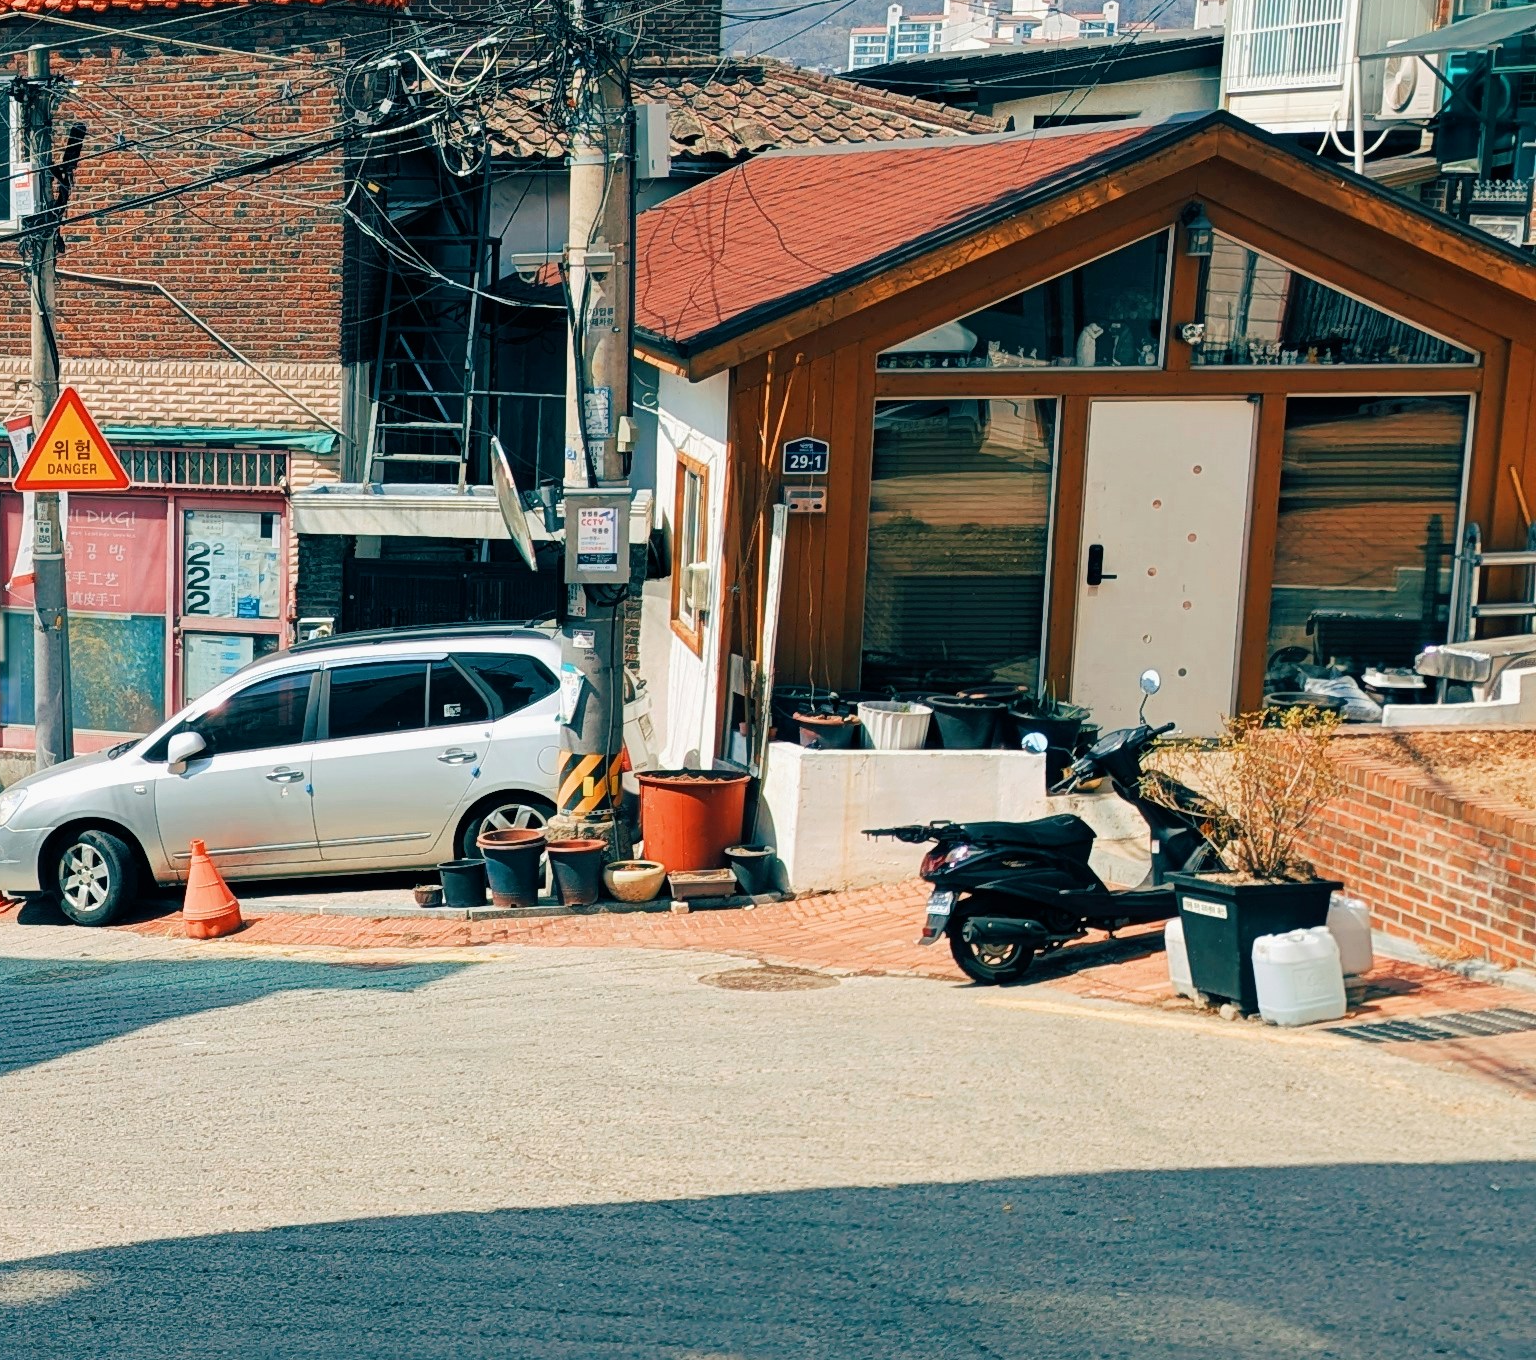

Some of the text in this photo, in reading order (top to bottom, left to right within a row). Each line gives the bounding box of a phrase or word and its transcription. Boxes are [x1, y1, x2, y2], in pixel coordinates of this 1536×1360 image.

[53, 439, 91, 460] 위험
[47, 463, 97, 475] DANGER
[790, 454, 822, 469] 29-1
[86, 509, 135, 528] DUGI
[581, 518, 604, 527] CCTV
